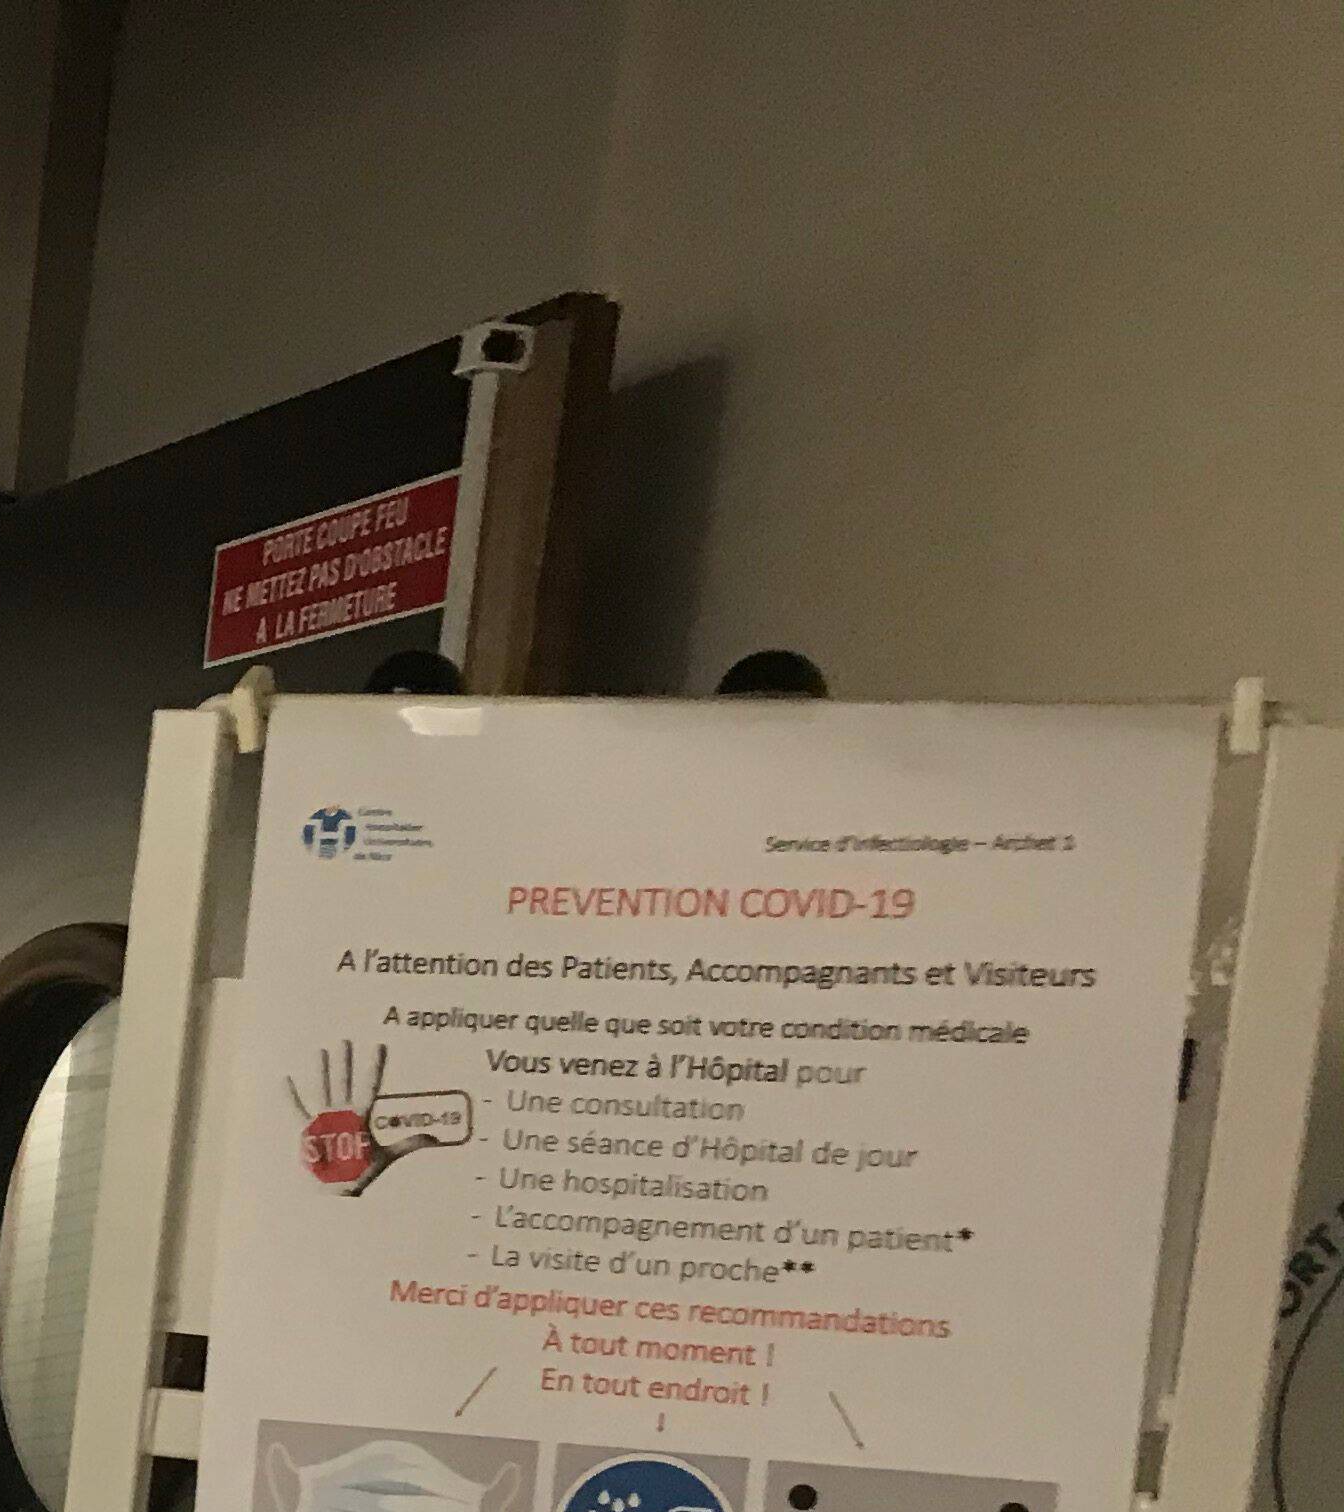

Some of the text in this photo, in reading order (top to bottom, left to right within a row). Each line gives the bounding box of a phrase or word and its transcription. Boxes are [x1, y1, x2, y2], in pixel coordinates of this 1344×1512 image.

[263, 497, 410, 566] PORTE COUPE FEU
[222, 526, 448, 616] NE METTEZ PAS D'OBSTACLE
[275, 609, 295, 639] LA
[298, 581, 398, 634] FERMETURE
[766, 836, 830, 852] Service
[507, 886, 916, 920] PREVENTION COVID-19
[338, 948, 1097, 989] A l'attention des Patients, Accompagnants et Visiteurs
[383, 1006, 1030, 1044] A appliquer quelle que soit votre condition médicale
[486, 1048, 867, 1088] Vous venez à l'Hôpital pour
[507, 1089, 746, 1121] Une consultation
[503, 1129, 918, 1172] Une séance d'Hôpital de jour
[499, 1168, 769, 1202] Une hospitalisation
[496, 1207, 766, 1243] L'accompagnement
[773, 1219, 839, 1247] d'un
[492, 1247, 521, 1269] La
[529, 1249, 602, 1274] visite
[609, 1251, 670, 1278] d'un
[391, 1279, 951, 1340] Merci d'appliquer ces recommandations
[542, 1323, 563, 1354] À
[570, 1333, 628, 1358] tout
[636, 1338, 756, 1368] moment
[541, 1368, 574, 1393] En
[582, 1371, 640, 1398] tout
[648, 1376, 750, 1406] endroit
